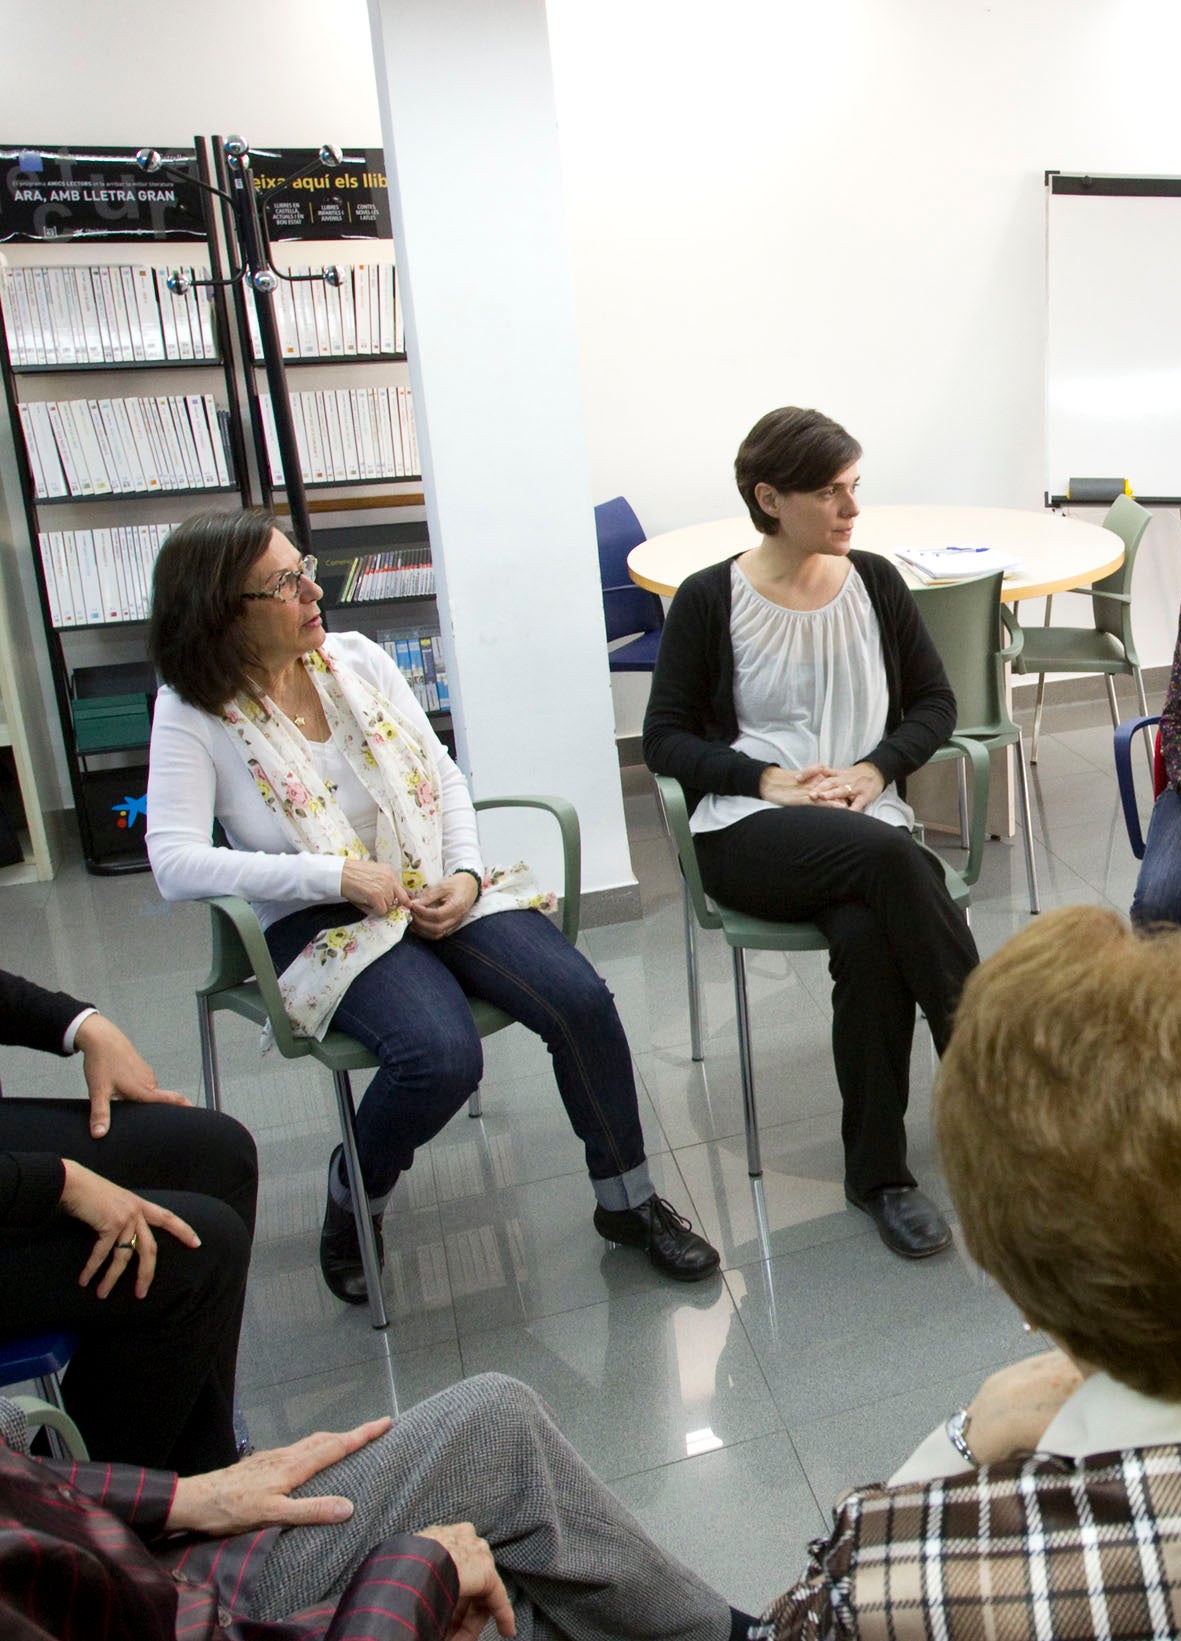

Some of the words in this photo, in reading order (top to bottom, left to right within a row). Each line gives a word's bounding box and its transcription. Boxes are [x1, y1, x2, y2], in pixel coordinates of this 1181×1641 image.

[47, 180, 66, 188] AMICS
[292, 171, 331, 192] aquí
[335, 173, 358, 189] els
[14, 189, 47, 203] ARA,
[50, 189, 80, 202] AMB
[83, 189, 136, 202] LLETRA
[137, 189, 175, 202] GRAN
